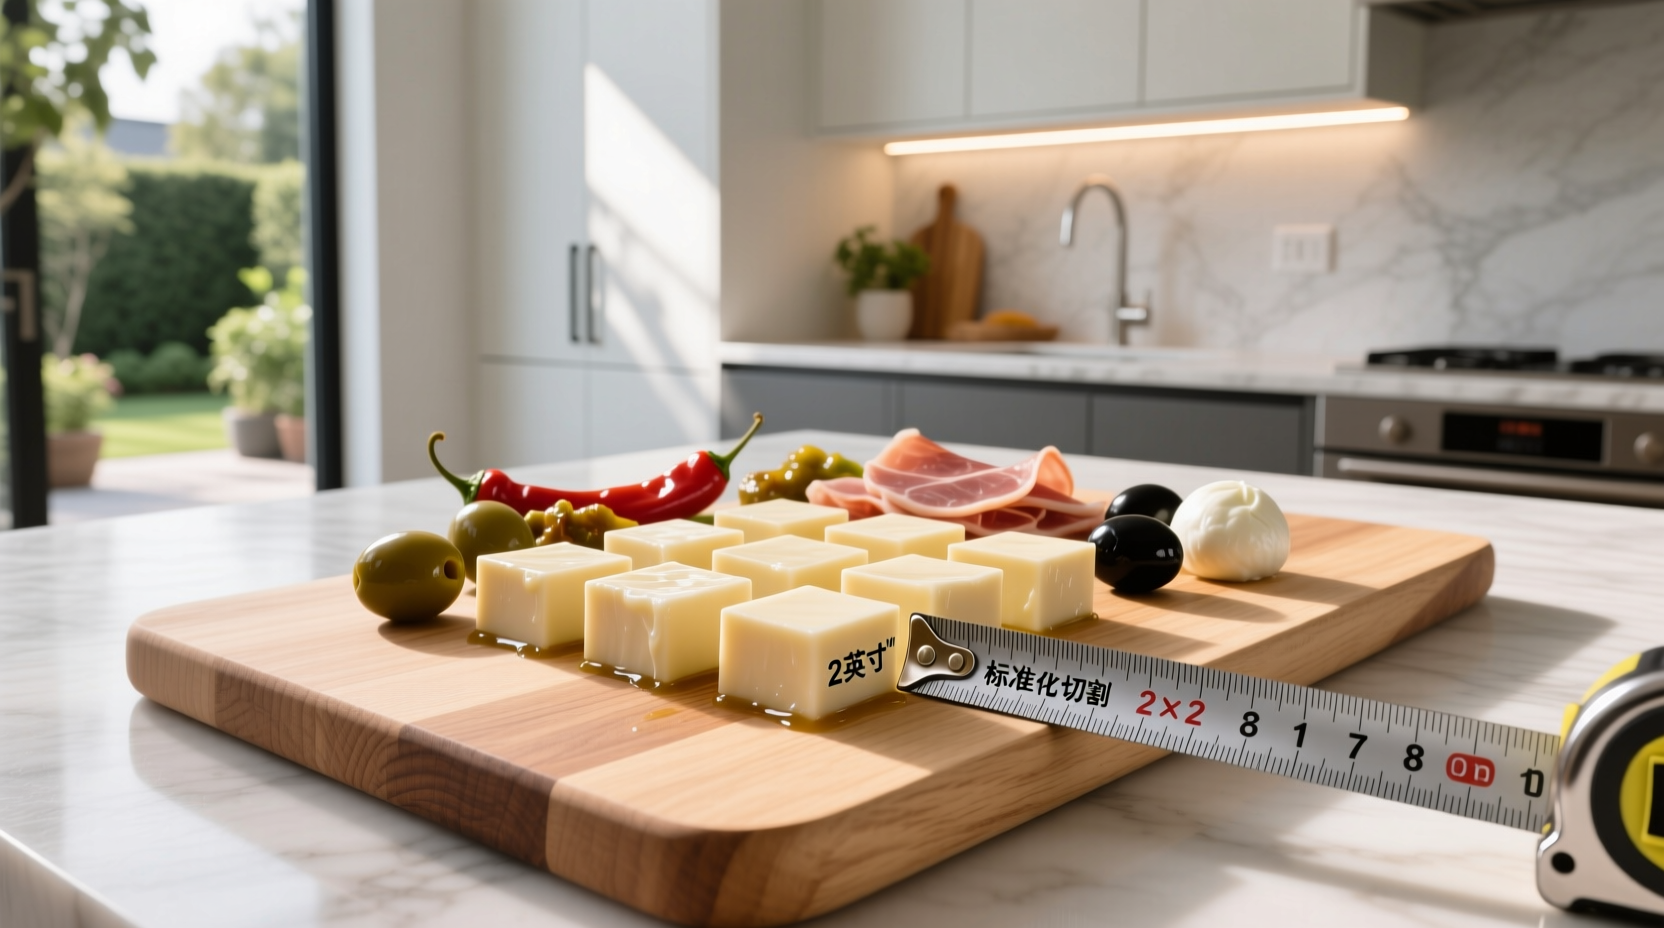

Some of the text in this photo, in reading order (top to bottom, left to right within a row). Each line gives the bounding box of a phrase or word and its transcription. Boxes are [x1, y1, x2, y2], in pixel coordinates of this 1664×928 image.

[984, 660, 1112, 708] 标准化切割
[1239, 711, 1260, 737] 8
[1293, 722, 1308, 748] 1
[1348, 733, 1368, 759] 7
[1403, 743, 1424, 772] 8
